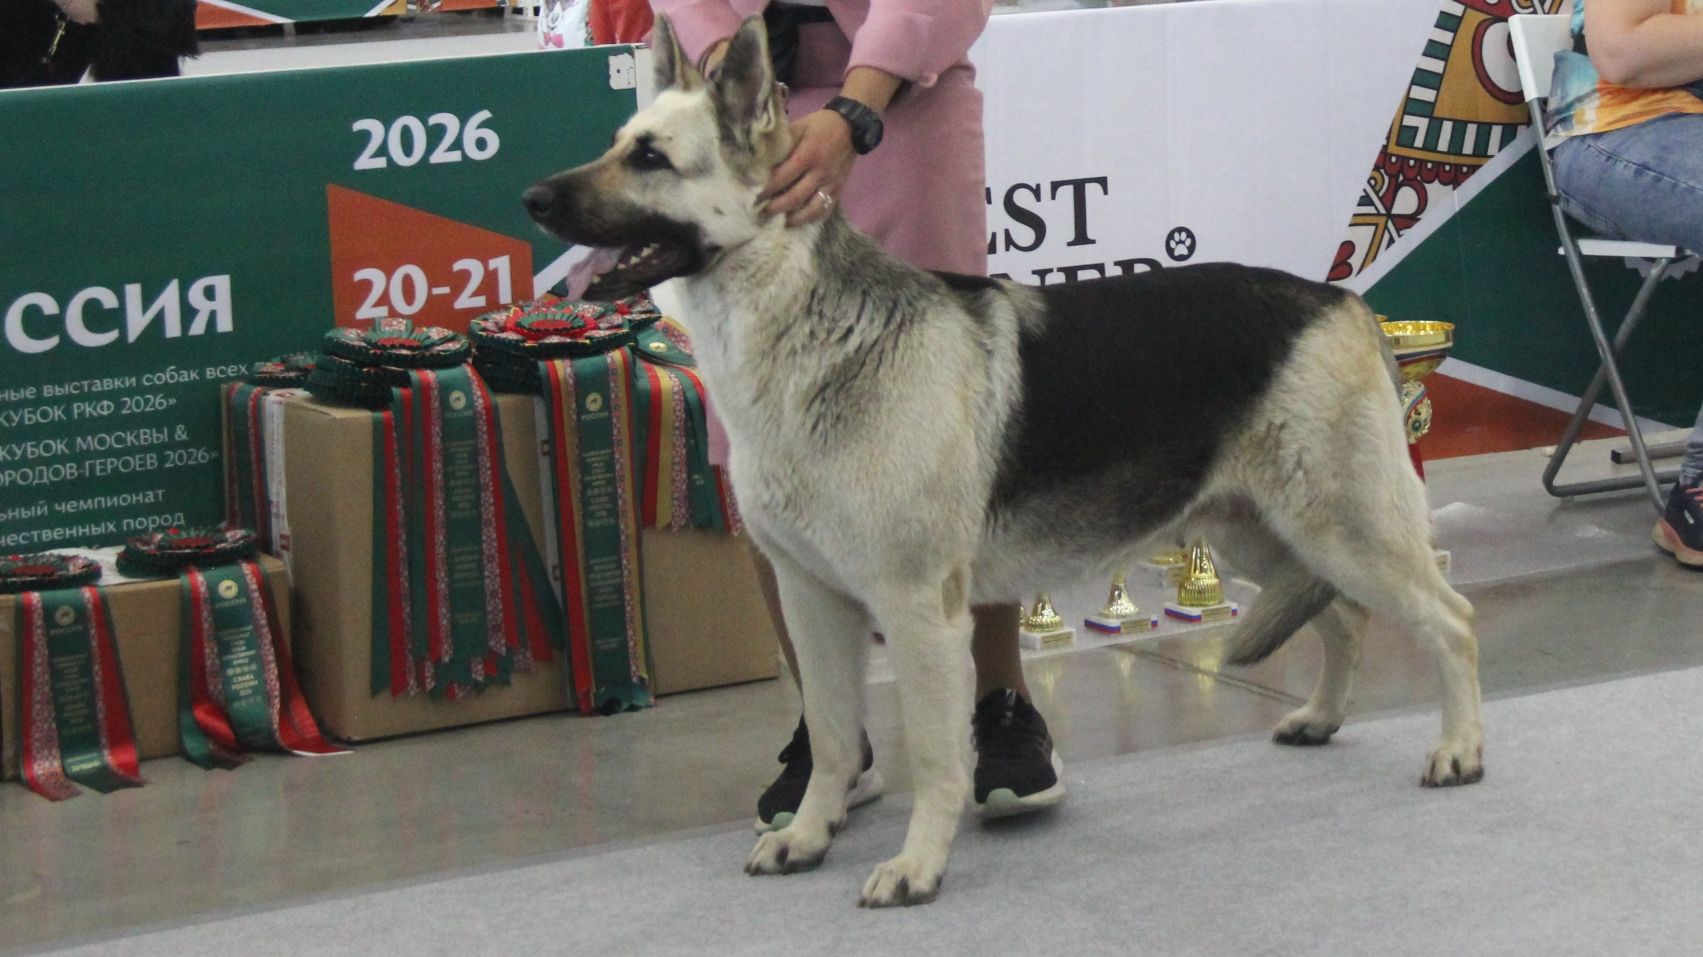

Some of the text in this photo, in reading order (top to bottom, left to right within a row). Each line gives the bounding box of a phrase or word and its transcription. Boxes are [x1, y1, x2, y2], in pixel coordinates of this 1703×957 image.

[352, 110, 501, 171] 2026
[353, 255, 513, 321] 20-21
[4, 274, 234, 354] ССИЯ
[43, 376, 137, 398] выставки
[142, 366, 199, 386] собак
[206, 363, 249, 379] всех
[73, 399, 114, 420] РКФ
[121, 394, 177, 415] 2026»
[0, 425, 189, 462] КУБОК МОСКВЫ &
[0, 448, 219, 488] РОДОВ-ГЕРОЕВ 2026»
[55, 489, 166, 514] чемпионат
[123, 512, 186, 533] пород
